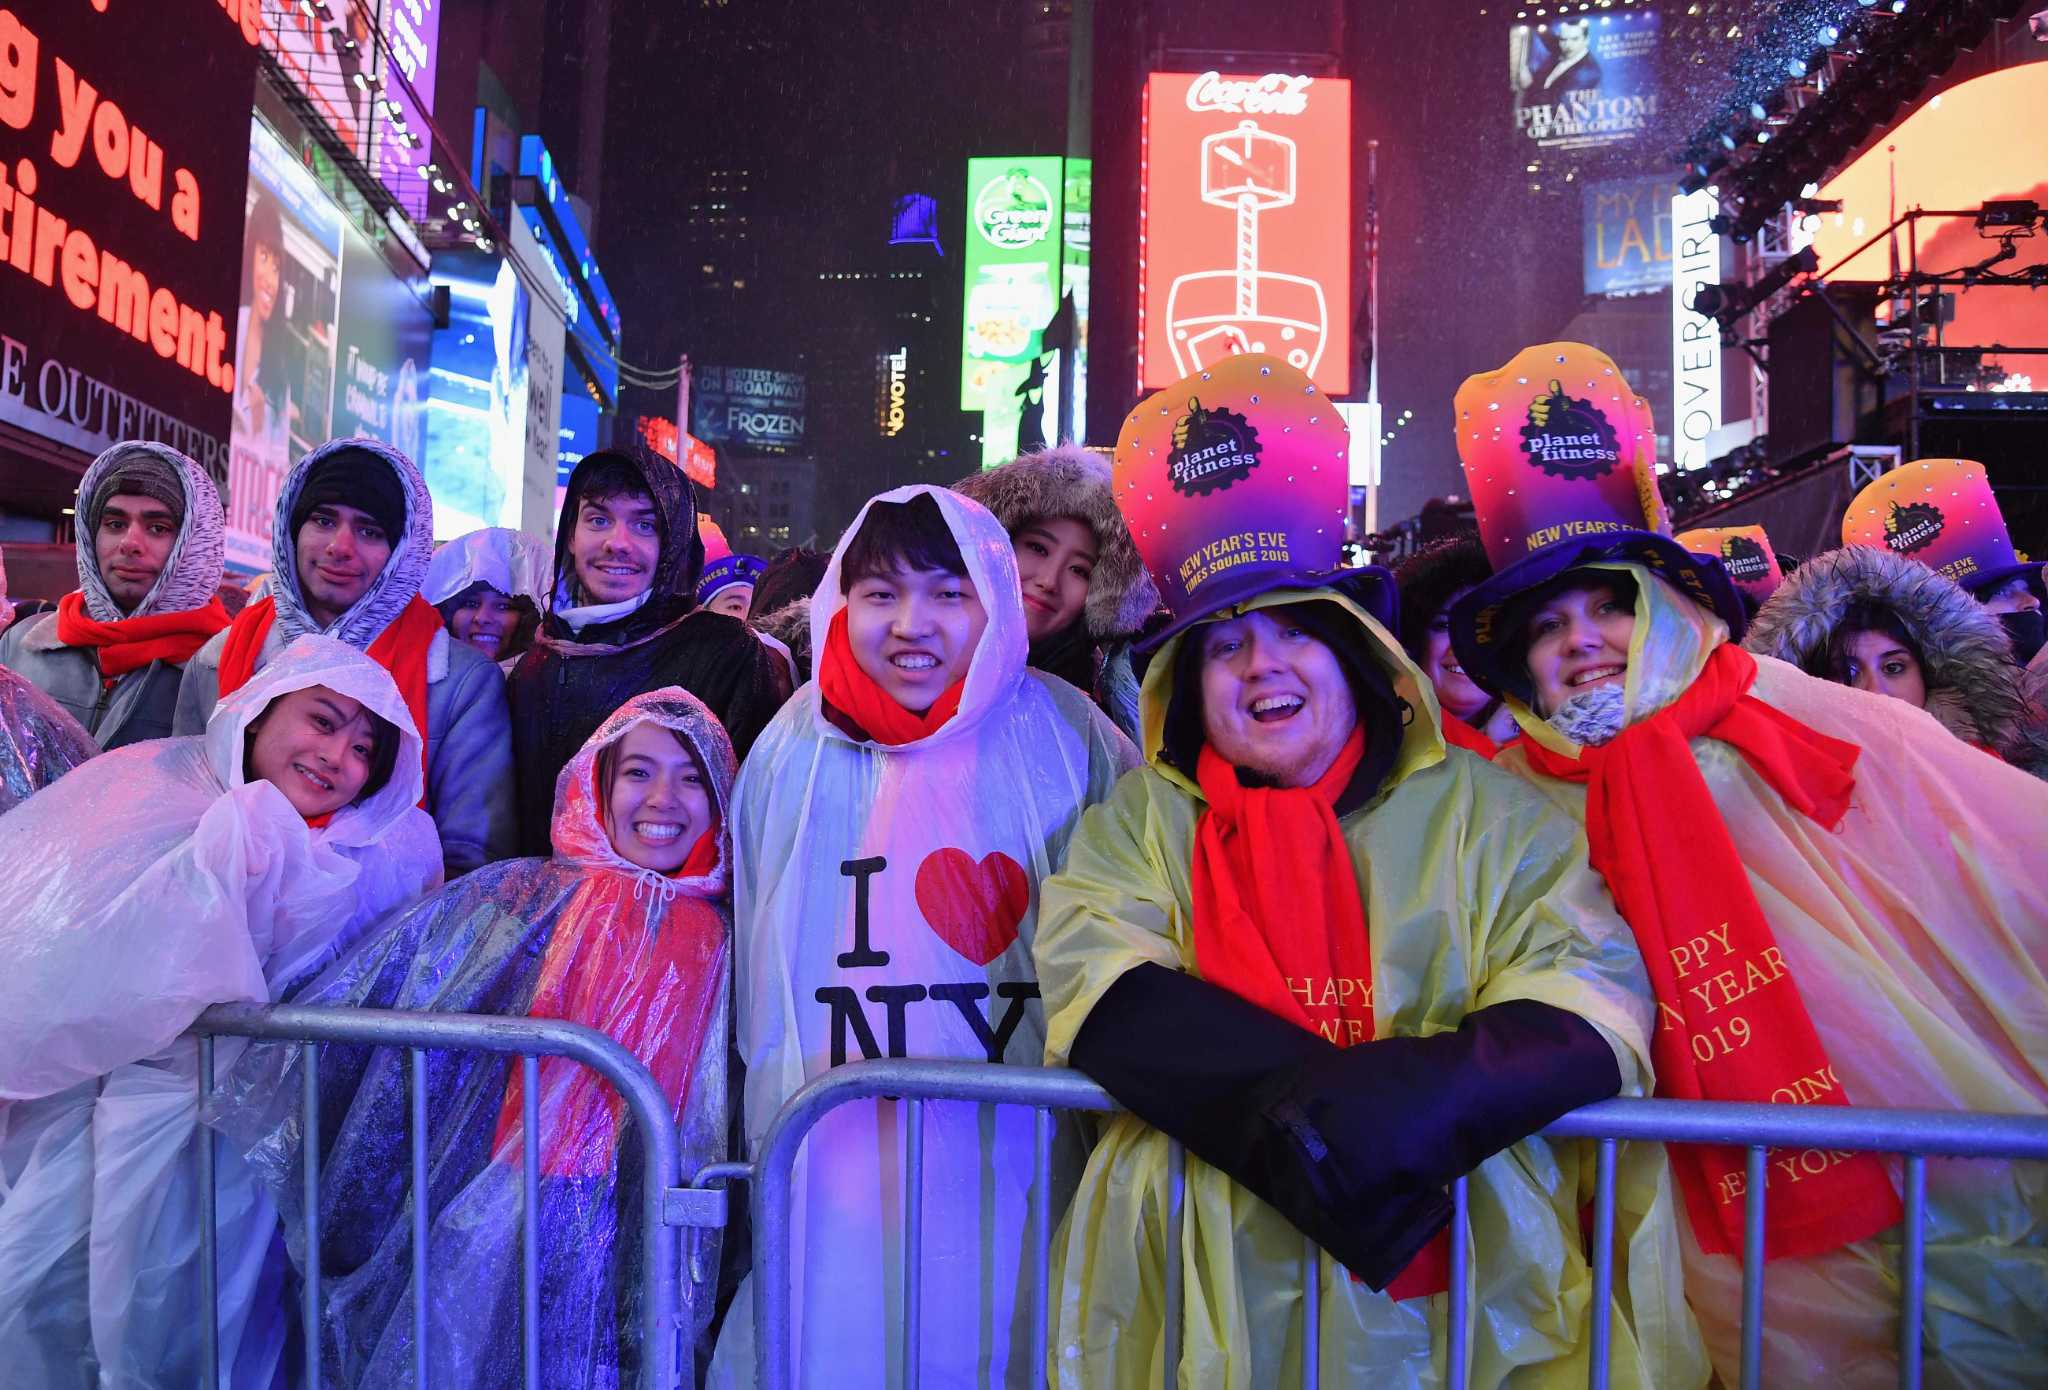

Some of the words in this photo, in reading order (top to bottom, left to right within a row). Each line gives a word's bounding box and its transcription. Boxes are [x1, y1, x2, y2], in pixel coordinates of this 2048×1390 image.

[1186, 71, 1314, 115] Coca-Cola
[1516, 95, 1657, 129] PHANTOM
[51, 56, 164, 212] you
[172, 168, 201, 241] a
[984, 208, 1047, 225] Green
[887, 346, 907, 437] NOVOTEL
[39, 358, 230, 487] OUTFITTERS
[727, 406, 805, 437] FROZEN
[1173, 438, 1238, 478] planet
[1528, 433, 1601, 452] planet
[1542, 446, 1617, 461] fitness
[1182, 452, 1255, 484] fitness
[1526, 525, 1560, 552] NEW
[1563, 521, 1618, 537] YEAR'S
[1889, 519, 1931, 549] planet
[1899, 522, 1942, 550] fitness
[1180, 551, 1201, 582] NEW
[1202, 533, 1255, 560] YEAR'S
[1258, 532, 1288, 548] EVE
[1185, 567, 1208, 596] TIMES
[1210, 551, 1258, 574] SQUARE
[1261, 550, 1289, 562] 2019
[1723, 555, 1761, 572] planet
[1731, 563, 1770, 575] fitness
[1954, 556, 1975, 570] EVE
[837, 856, 890, 968] I
[1689, 946, 1788, 1014] YEAR
